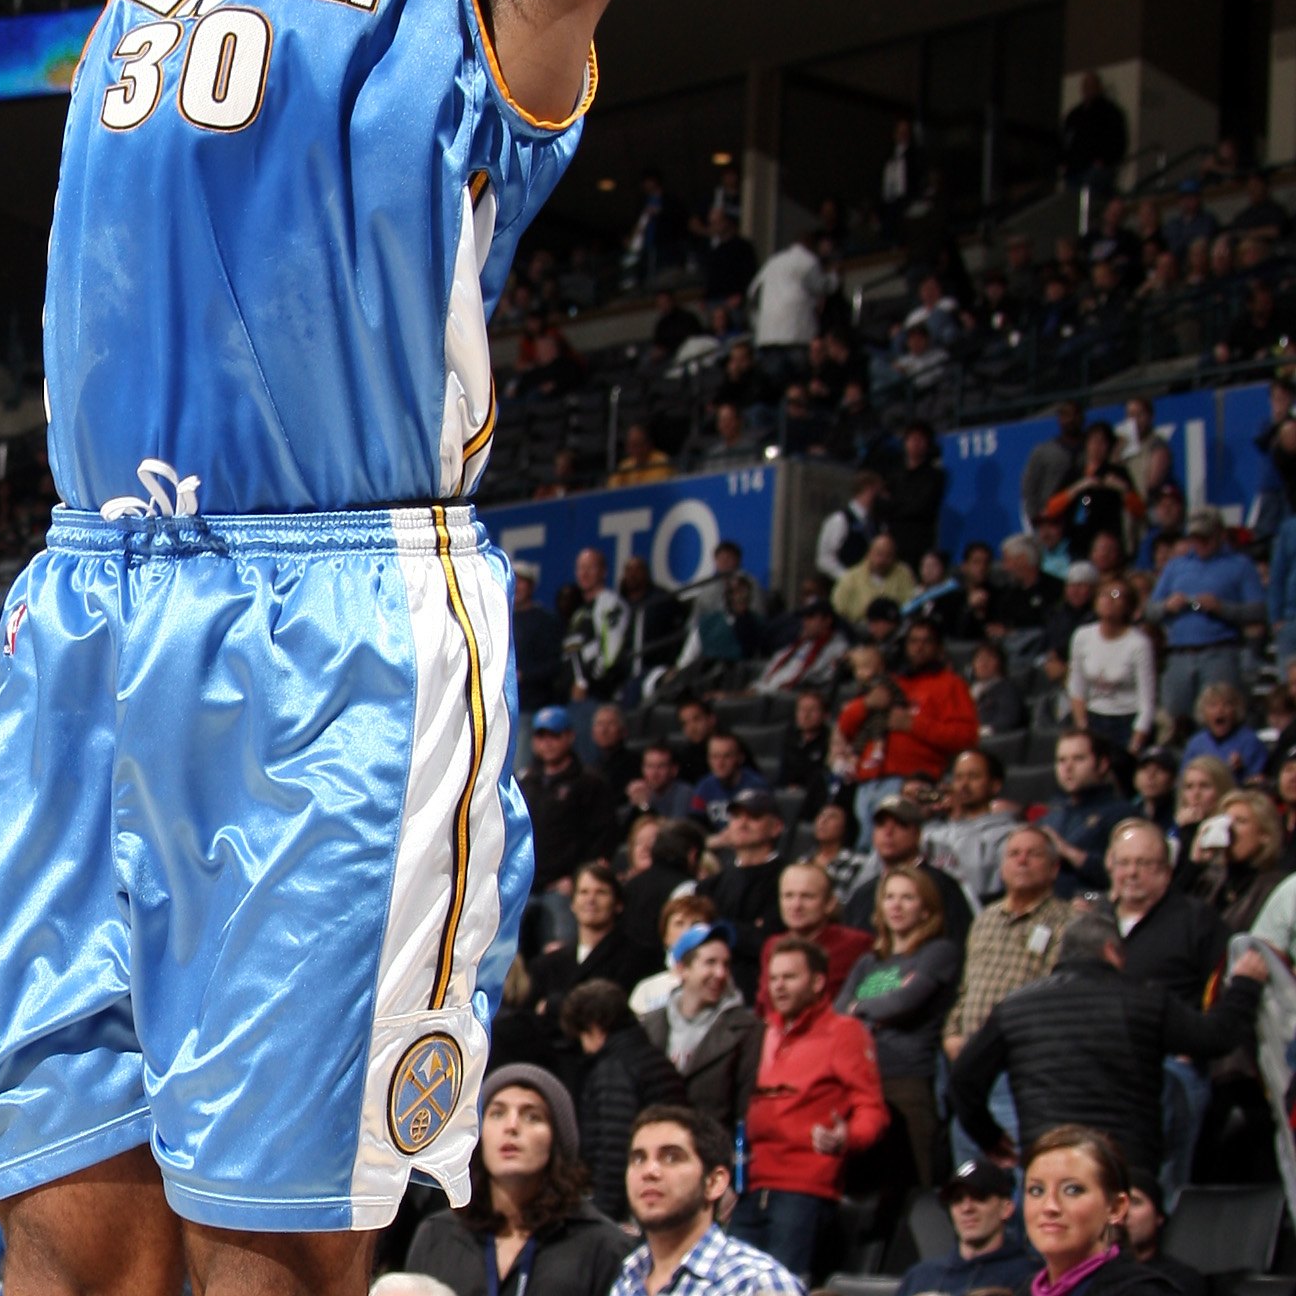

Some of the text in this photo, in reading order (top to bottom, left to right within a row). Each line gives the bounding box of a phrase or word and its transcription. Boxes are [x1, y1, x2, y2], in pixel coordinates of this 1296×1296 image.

[99, 4, 274, 134] 30
[957, 428, 998, 459] 115
[727, 469, 764, 496] 114
[598, 497, 721, 593] TO
